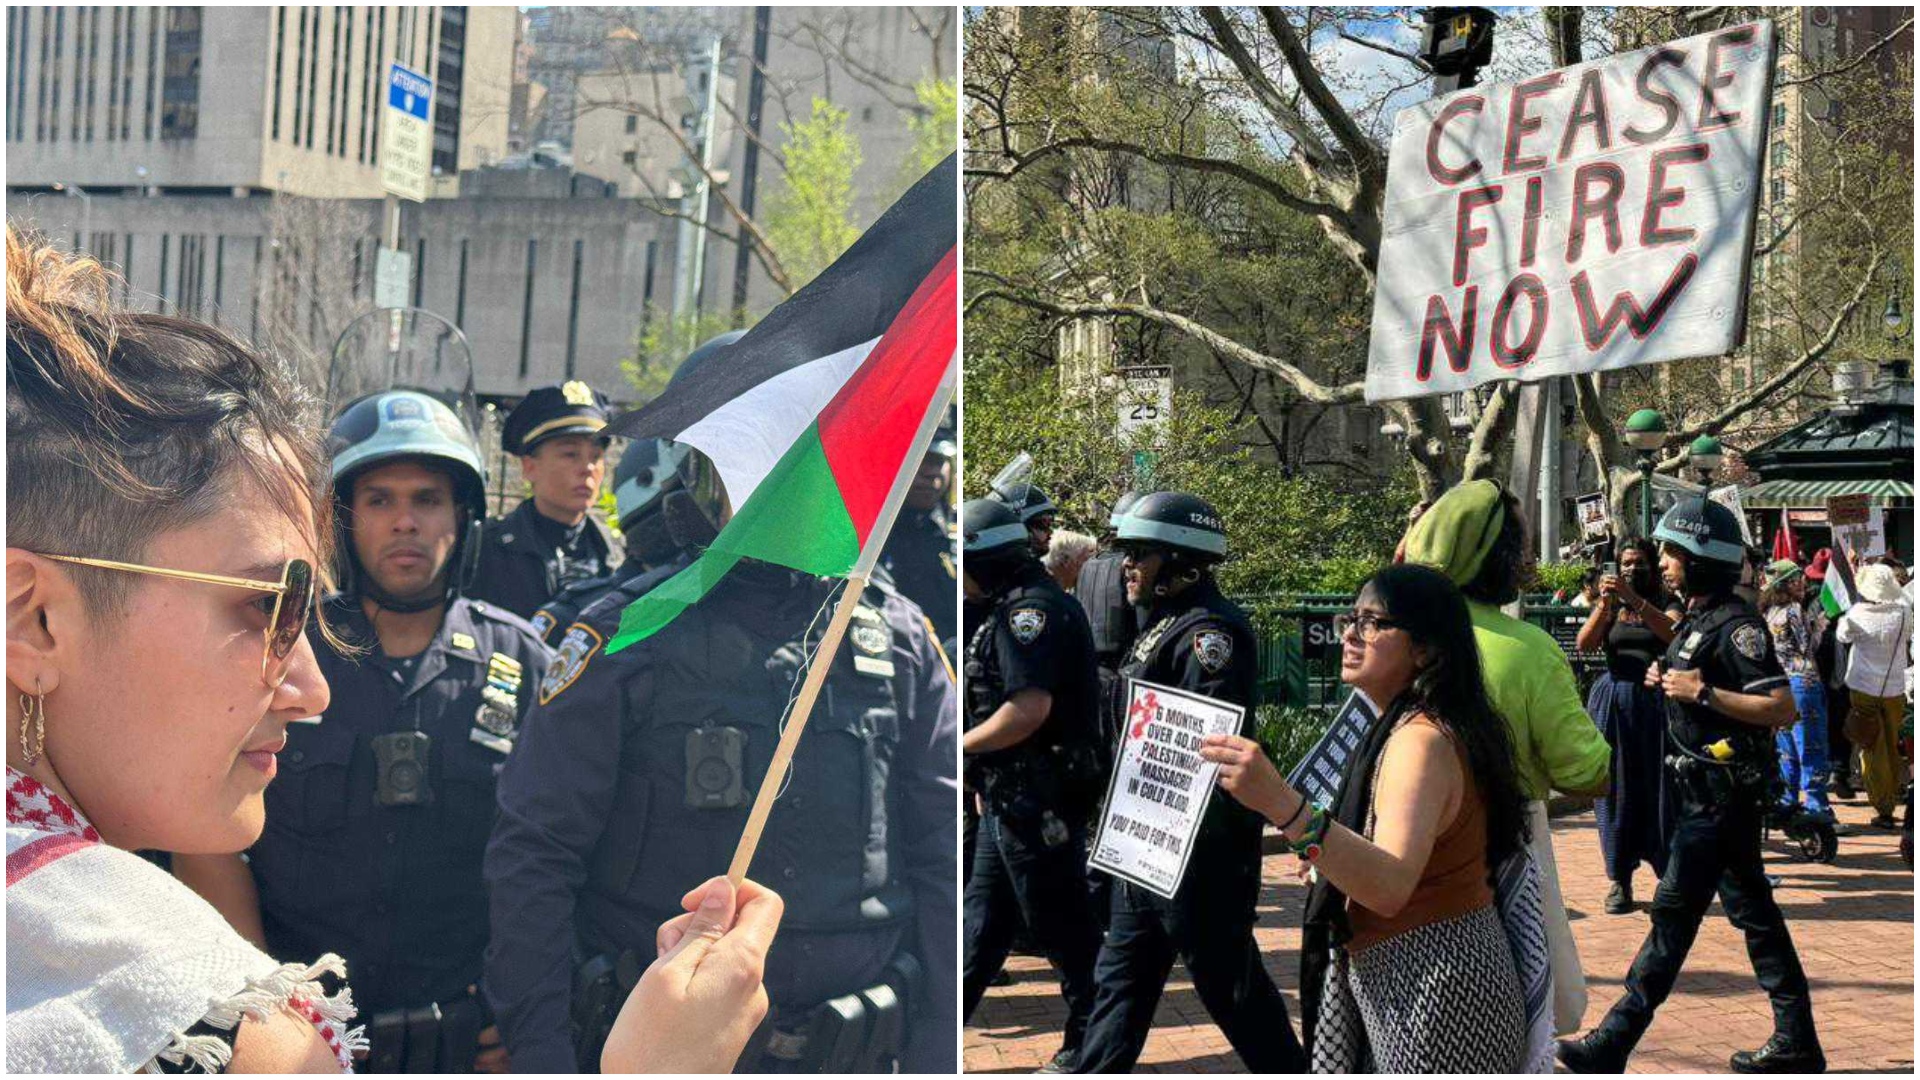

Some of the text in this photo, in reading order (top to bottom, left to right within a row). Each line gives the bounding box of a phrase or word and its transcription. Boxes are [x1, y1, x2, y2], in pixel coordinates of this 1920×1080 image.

[1426, 24, 1760, 185] CEASE
[1452, 143, 1709, 287] FIRE
[1416, 252, 1698, 381] NOW
[1130, 404, 1158, 420] 25
[1156, 705, 1164, 721] 6
[1147, 723, 1173, 744] OVER
[1127, 777, 1140, 796] IN
[1140, 781, 1165, 803] COLD
[1108, 813, 1130, 833] YOU
[1127, 819, 1150, 841] PAID
[1148, 827, 1167, 848] FOR
